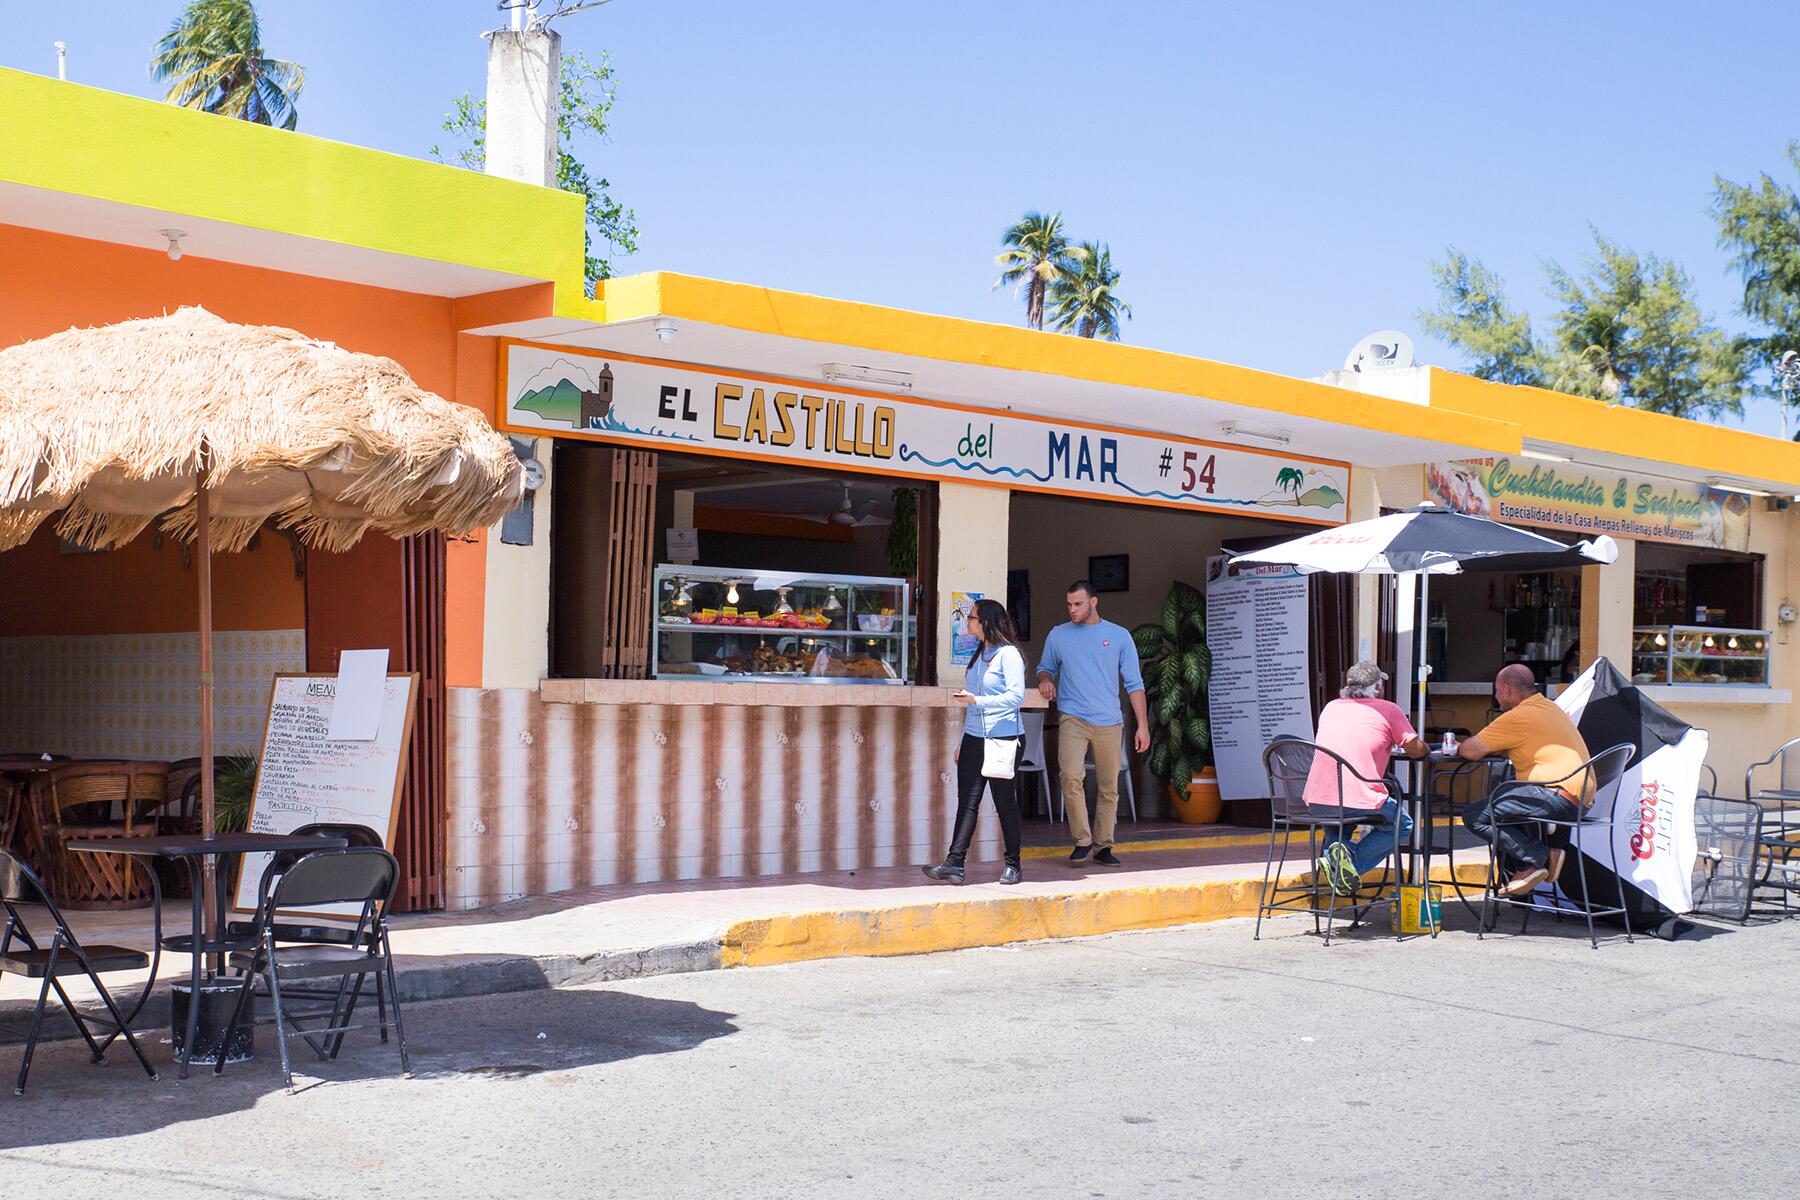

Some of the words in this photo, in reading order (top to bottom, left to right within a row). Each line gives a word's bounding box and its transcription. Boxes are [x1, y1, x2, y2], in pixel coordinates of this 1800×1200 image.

[658, 385, 698, 422] EL
[713, 382, 896, 459] CASTILLO
[957, 423, 994, 459] del
[1049, 431, 1119, 483] MAR
[1500, 502, 1552, 524] Especialidad
[1553, 511, 1564, 526] de
[1564, 512, 1573, 527] la
[1574, 513, 1591, 528] Casa
[1593, 515, 1619, 533] Arepas
[1653, 523, 1663, 537] de
[1664, 524, 1694, 541] Mariscos
[1612, 478, 1628, 509] &
[1632, 484, 1708, 528] Seafood
[1630, 780, 1659, 861] Coors
